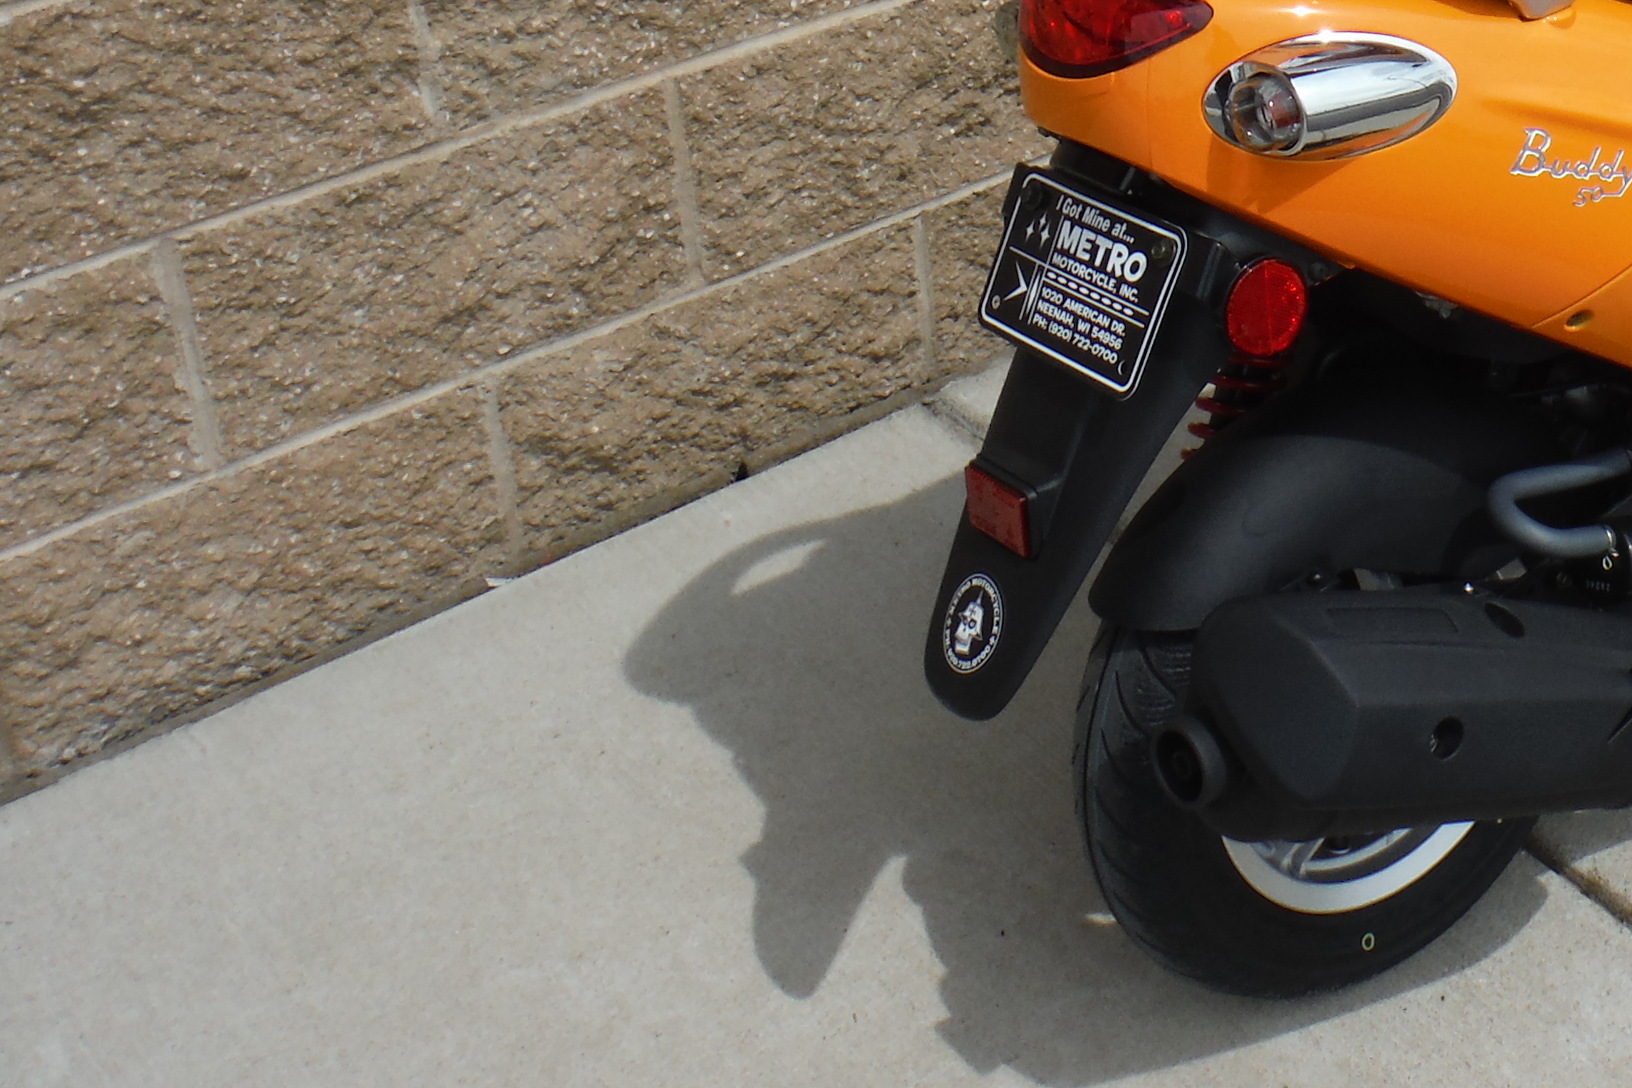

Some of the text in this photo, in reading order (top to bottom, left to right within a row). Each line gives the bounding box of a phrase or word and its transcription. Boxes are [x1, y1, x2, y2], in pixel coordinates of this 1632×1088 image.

[1056, 194, 1135, 243] I Got Mine at...
[1051, 252, 1117, 294] MOTORCYCLE,
[1056, 219, 1148, 282] METRO
[1036, 299, 1123, 350] NEENAH, WI 54956
[1041, 286, 1126, 337] 1020 AMERICAN DR.
[1048, 320, 1073, 342] (920)
[1072, 333, 1118, 364] 722-0700
[972, 577, 1000, 635] MOTORCYCLE
